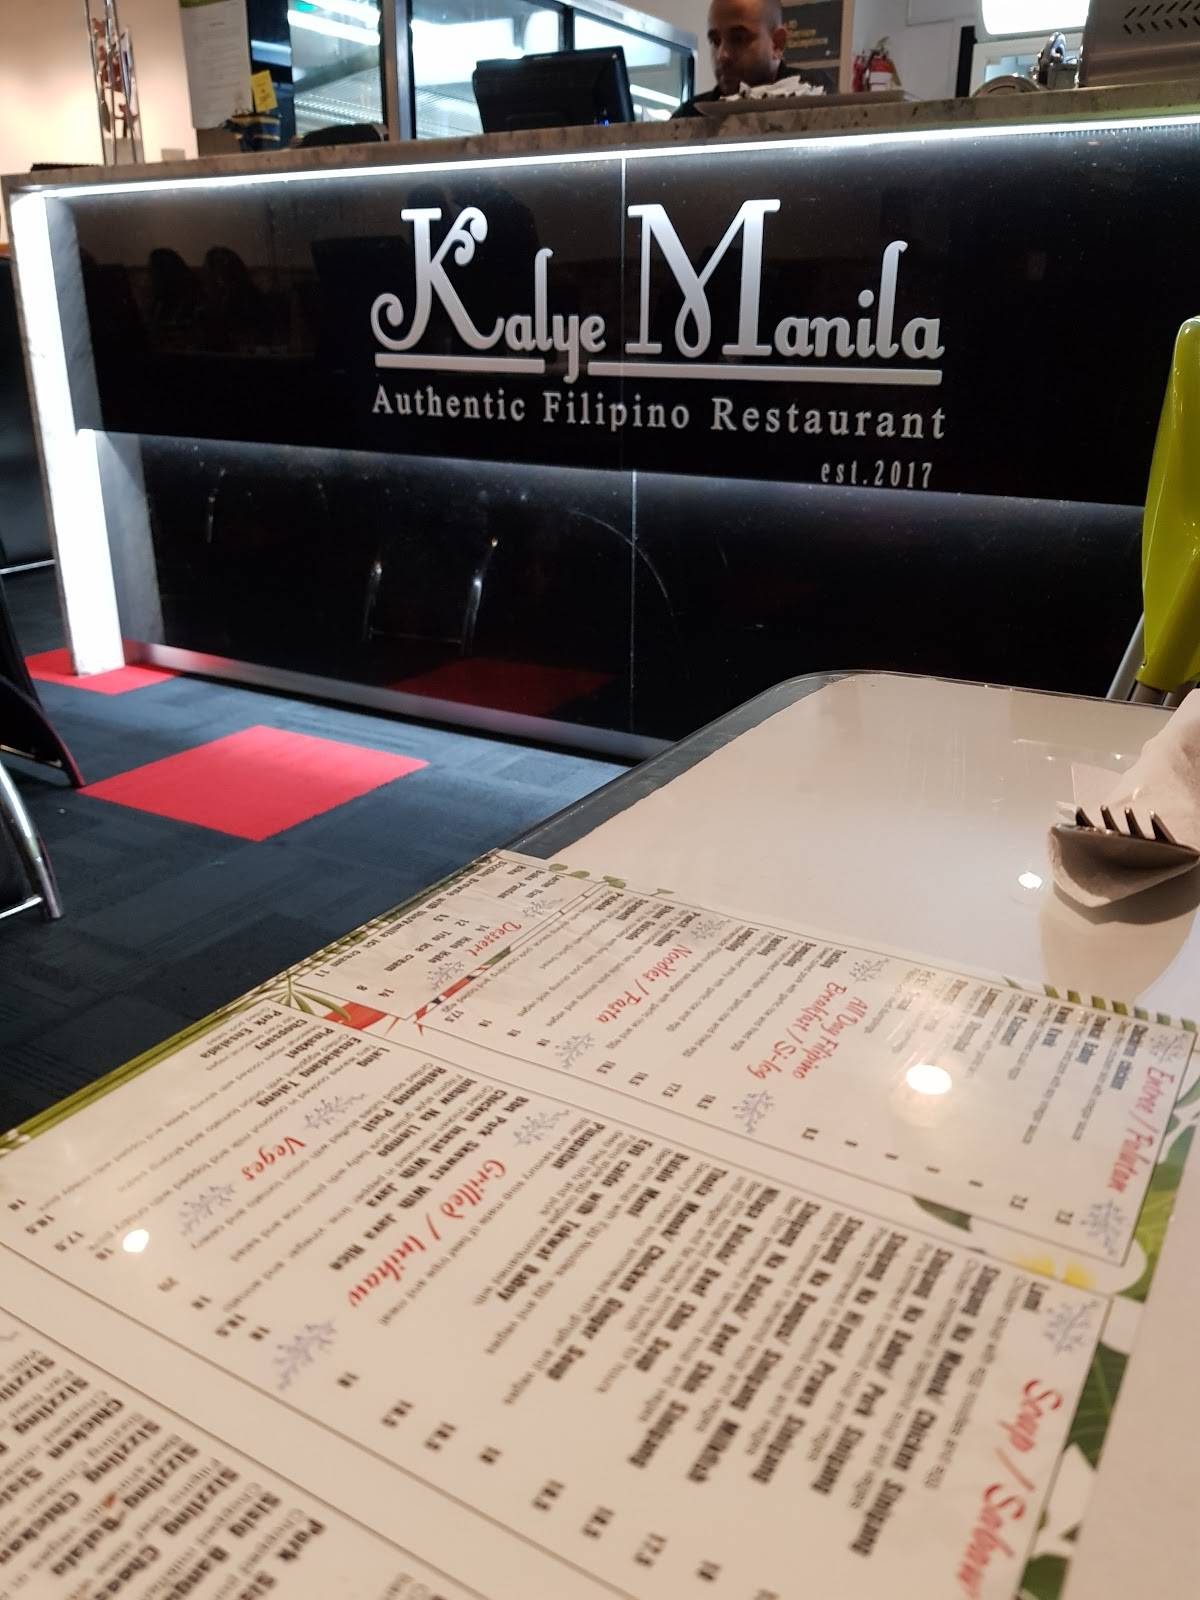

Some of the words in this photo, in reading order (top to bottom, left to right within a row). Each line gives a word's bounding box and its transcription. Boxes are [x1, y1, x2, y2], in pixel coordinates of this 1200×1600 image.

[370, 206, 607, 384] Kalye
[624, 199, 946, 360] Manila
[372, 384, 526, 422] Authentic
[543, 391, 690, 433] Filipino
[711, 397, 946, 439] Restaurant
[820, 459, 933, 489] est.2017
[453, 918, 470, 927] 12
[464, 920, 523, 957] Dessert
[640, 943, 694, 982] Noodles
[376, 988, 395, 997] 14
[595, 990, 643, 1024] Pasta
[790, 981, 848, 1032] Breakfast
[844, 996, 870, 1017] All
[252, 1009, 283, 1026] Pork
[252, 1017, 308, 1051] Chopsuey
[818, 1012, 859, 1037] Day
[198, 1027, 254, 1059] Ensalada
[284, 1027, 334, 1059] Pinakbet
[297, 1035, 361, 1078] Ensaladang
[355, 1046, 389, 1067] Laing
[788, 1034, 840, 1080] Filipino
[254, 1079, 300, 1107] Talong
[437, 1077, 477, 1105] Inihaw
[462, 1088, 508, 1122] Chicken
[1134, 1066, 1175, 1115] Entree
[417, 1107, 441, 1122] Na
[476, 1115, 507, 1137] Pork
[236, 1134, 306, 1182] Veges
[375, 1123, 422, 1158] Liempo
[427, 1124, 467, 1154] Inasal
[626, 1138, 653, 1157] Egg
[397, 1156, 431, 1180] With
[427, 1140, 480, 1181] Skewers
[364, 1182, 399, 1208] Java
[396, 1184, 431, 1210] With
[437, 1158, 509, 1220] Grilled
[574, 1191, 603, 1216] with
[625, 1186, 660, 1217] Mami
[362, 1212, 398, 1240] Java
[533, 1219, 580, 1261] Tokwat
[776, 1201, 821, 1248] Sinigang
[819, 1216, 863, 1265] Sinigang
[328, 1243, 365, 1272] Rice
[345, 1234, 429, 1309] Inihaw
[617, 1244, 666, 1293] Chicken
[762, 1251, 787, 1270] Na
[864, 1231, 908, 1282] Sinigang
[911, 1247, 954, 1300] Sinigang
[495, 1263, 540, 1302] Baboy
[689, 1266, 721, 1298] Beef
[806, 1268, 832, 1288] Na
[852, 1286, 877, 1306] Na
[959, 1264, 1001, 1318] Sinigang
[580, 1296, 624, 1340] Ginger
[663, 1300, 697, 1332] Shin
[899, 1304, 925, 1325] Na
[949, 1322, 975, 1344] Na
[633, 1336, 671, 1373] Soup
[706, 1322, 740, 1356] Beef
[0, 1357, 55, 1401] Sizzli
[545, 1344, 586, 1382] Soup
[679, 1359, 715, 1395] Shin
[728, 1348, 782, 1412] Sinigang
[11, 1376, 89, 1436] Sizzling
[851, 1381, 887, 1419] Pork
[997, 1376, 1064, 1455] Soup
[46, 1397, 125, 1461] Chicken
[627, 1399, 688, 1470] Sinigang
[890, 1407, 937, 1473] Chicken
[81, 1419, 161, 1484] Sizzling
[749, 1413, 806, 1485] Sinigang
[810, 1424, 864, 1497] Sinigang
[0, 1467, 42, 1507] Sisi
[120, 1443, 199, 1510] Sizzling
[160, 1466, 239, 1537] Sizzling
[226, 1491, 281, 1540] Sisig
[849, 1477, 904, 1558] Sinigang
[275, 1517, 326, 1564] Pork
